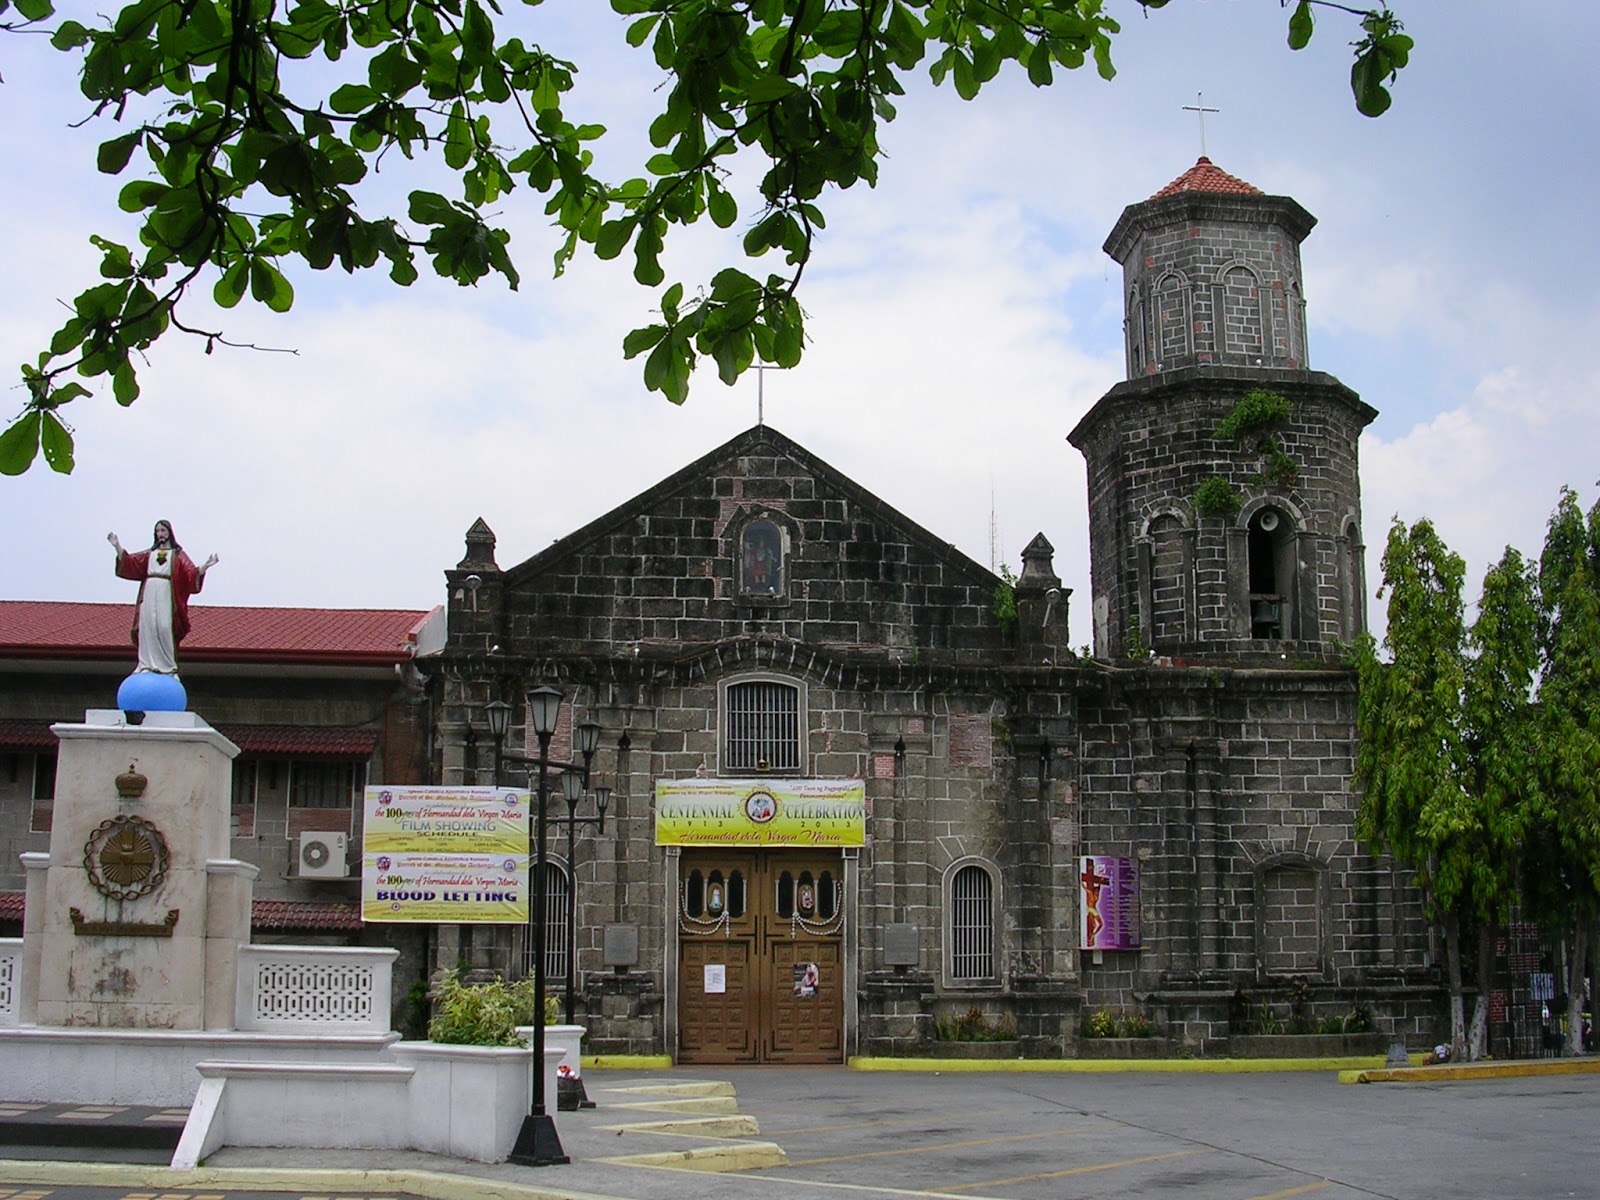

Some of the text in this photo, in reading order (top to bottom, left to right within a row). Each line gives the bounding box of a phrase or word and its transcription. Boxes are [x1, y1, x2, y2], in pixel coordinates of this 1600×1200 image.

[375, 807, 385, 817] the
[386, 807, 402, 818] 100
[415, 807, 423, 820] of
[423, 807, 462, 818] Hermandad
[478, 809, 499, 822] Virgen
[501, 809, 522, 818] Maria
[661, 803, 735, 819] CENTENNIAL
[785, 804, 863, 820] CELEBRATION
[402, 820, 497, 832] FILM SHOWING
[680, 830, 740, 843] Hermandad
[766, 830, 799, 843] Virgen
[801, 830, 842, 843] Maria
[376, 874, 386, 885] the
[387, 875, 403, 885] 100
[415, 875, 423, 887] of
[423, 875, 460, 885] Hermandad
[475, 877, 496, 890] Virgen
[498, 877, 518, 886] Maria
[377, 890, 517, 902] BLOOD LETTING
